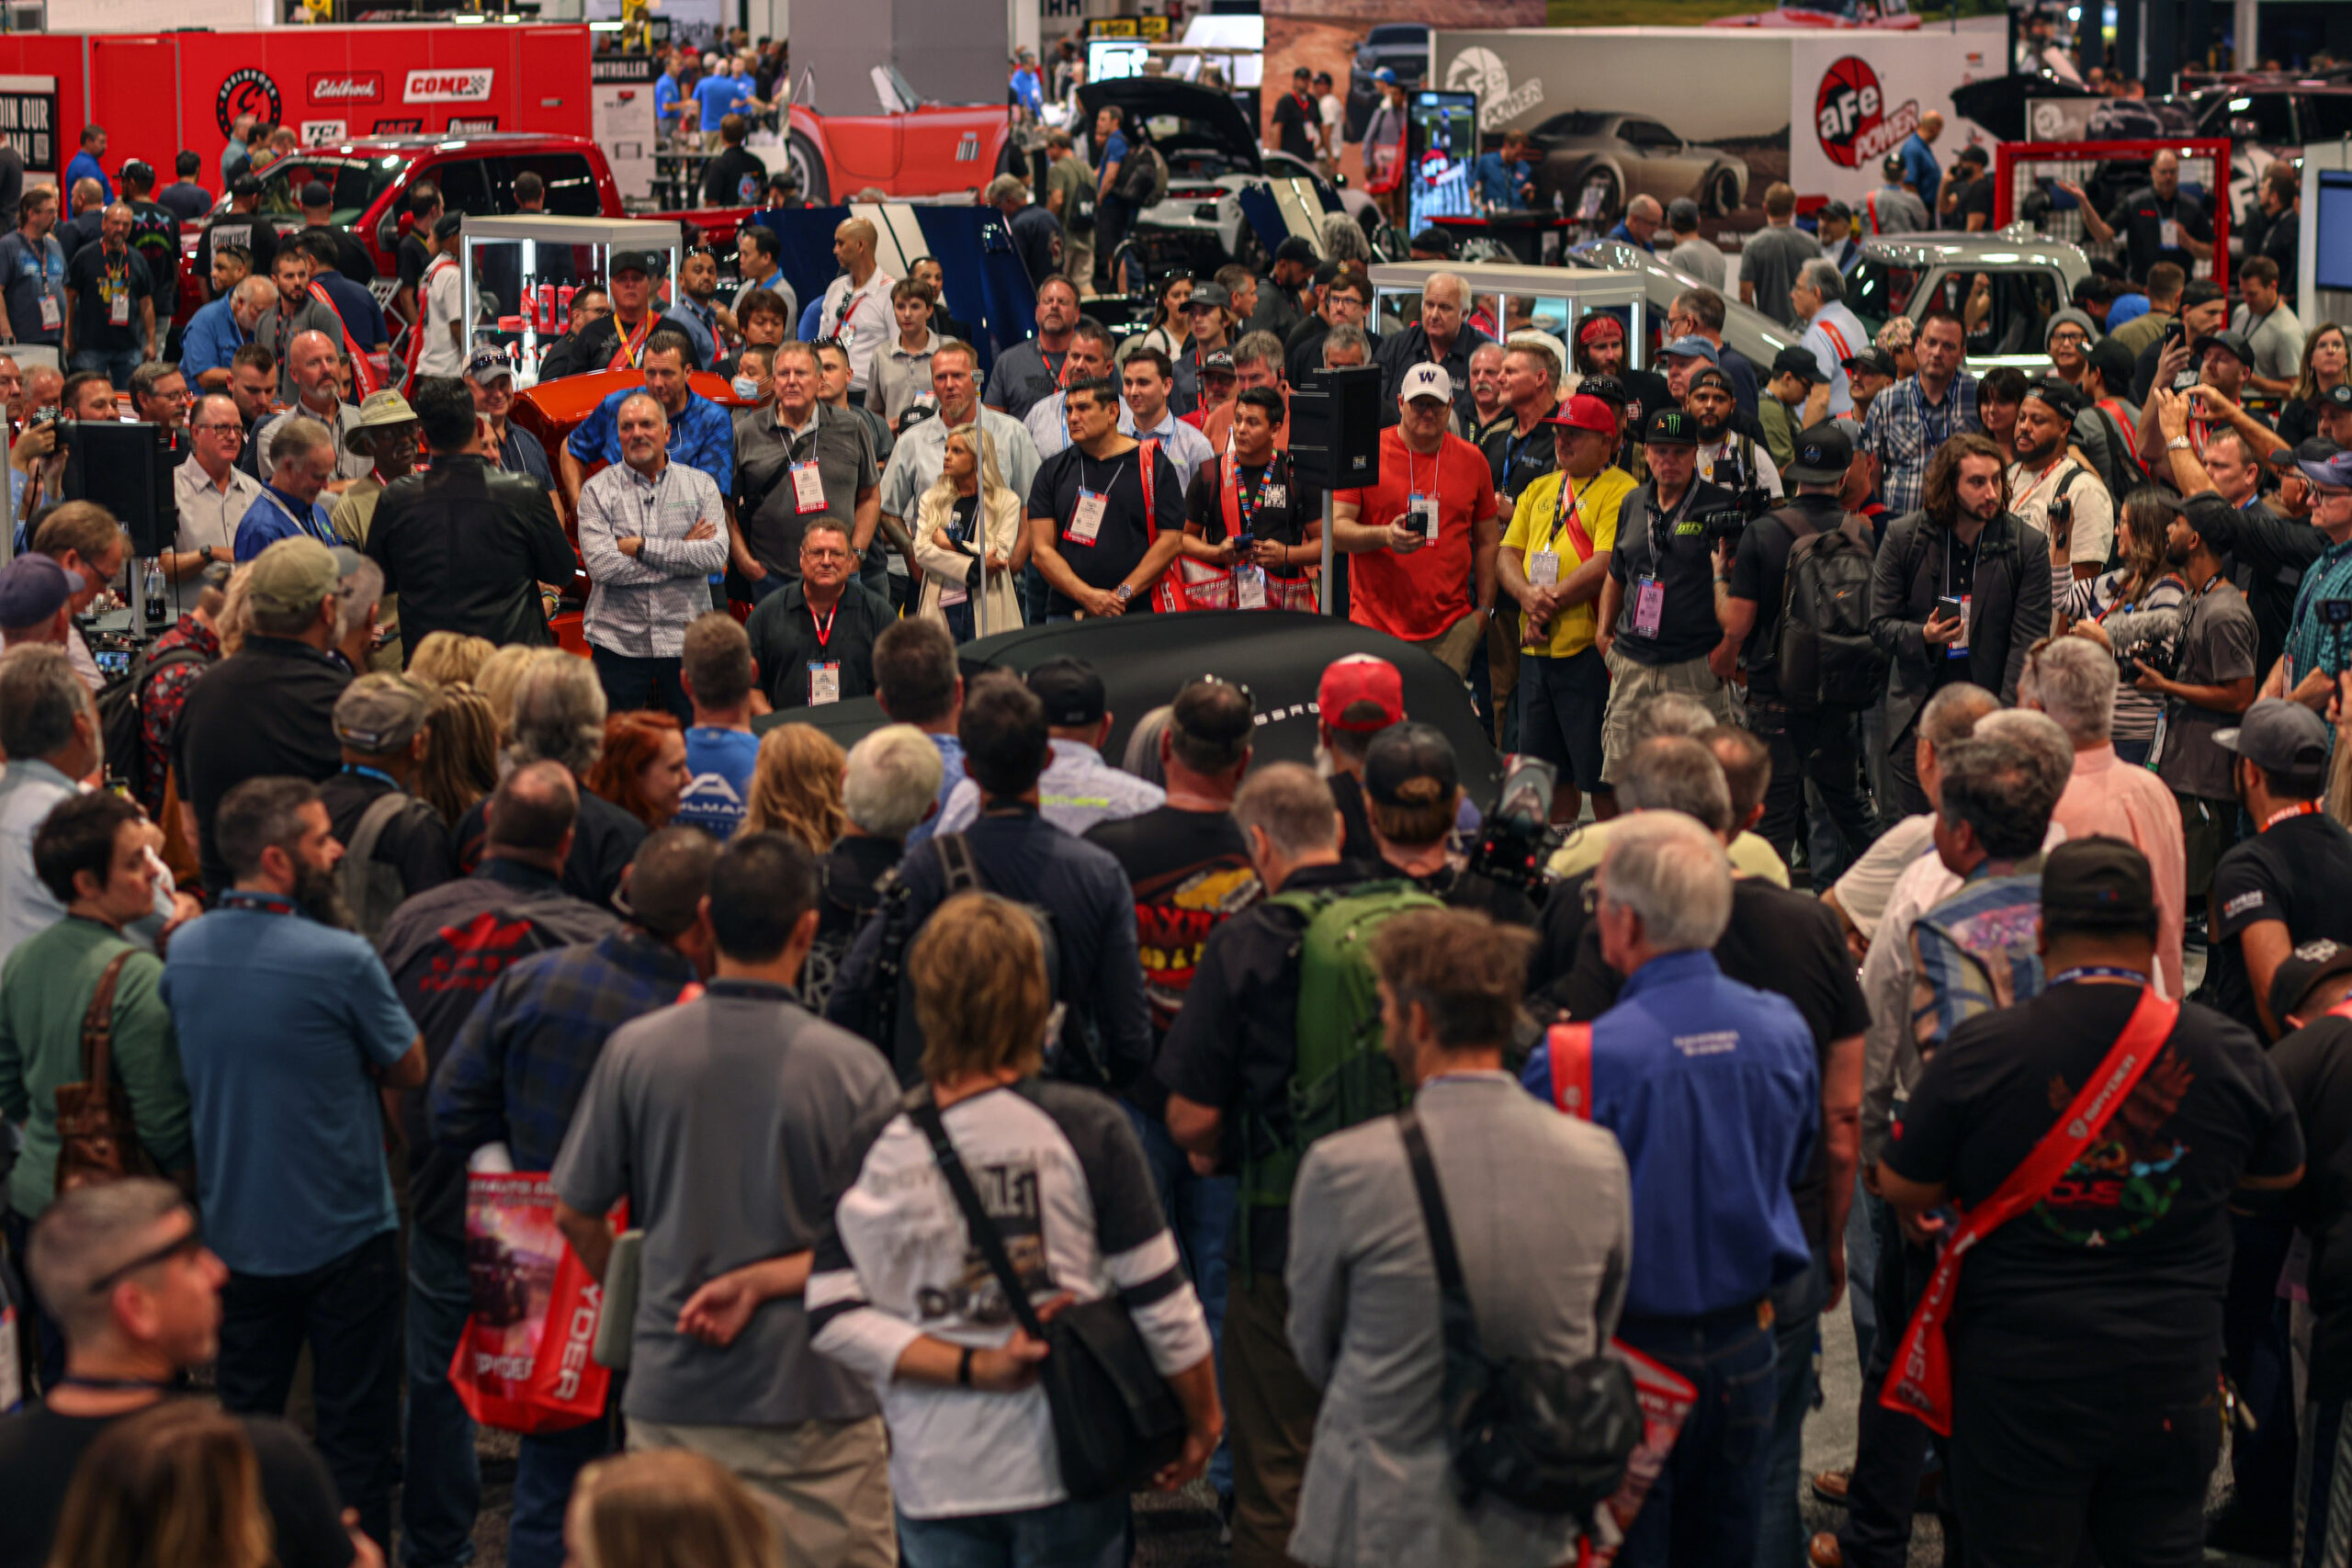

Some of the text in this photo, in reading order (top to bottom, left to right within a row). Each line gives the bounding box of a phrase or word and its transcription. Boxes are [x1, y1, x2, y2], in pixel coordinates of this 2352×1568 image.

[592, 62, 650, 77] ONTROLLER
[313, 79, 375, 98] Edelbrock
[411, 77, 469, 95] COMP
[22, 96, 49, 130] OUR
[1820, 85, 1880, 141] aFe
[1854, 101, 1919, 167] POWER
[1419, 370, 1436, 383] W
[554, 1281, 605, 1402] YDER
